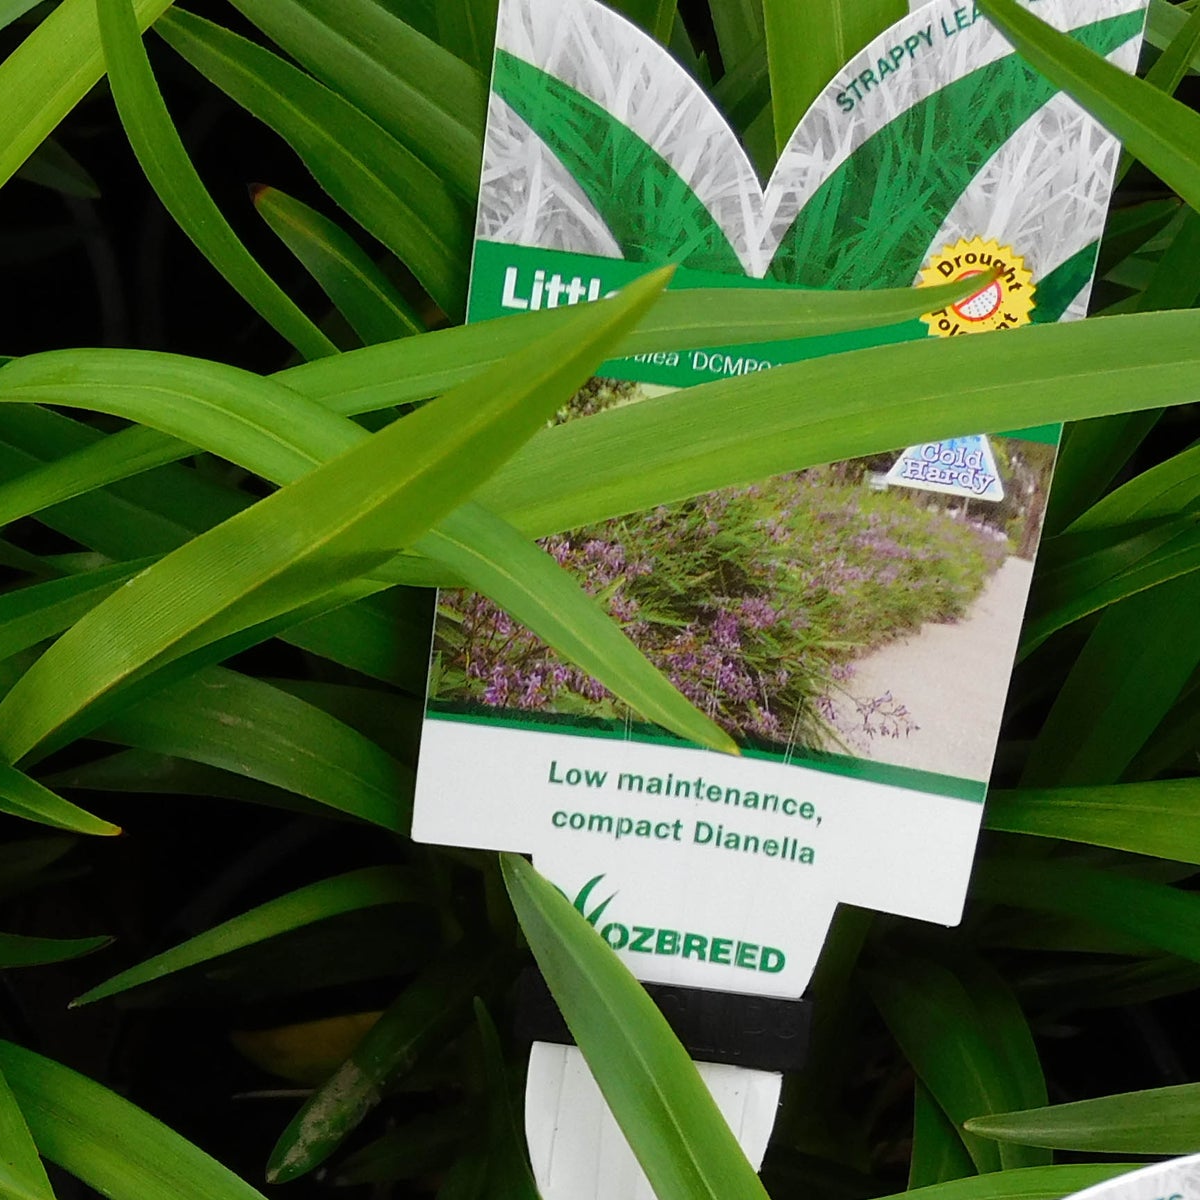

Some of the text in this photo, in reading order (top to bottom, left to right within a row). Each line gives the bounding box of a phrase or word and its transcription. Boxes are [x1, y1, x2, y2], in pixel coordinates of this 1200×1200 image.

[836, 24, 934, 113] STRAPPY
[502, 266, 622, 311] Littl
[902, 457, 995, 494] Hardy
[920, 443, 984, 471] Cold
[548, 760, 823, 826] Low maintenance,
[551, 810, 816, 865] compact Dianella
[600, 922, 786, 974] OZBREED
